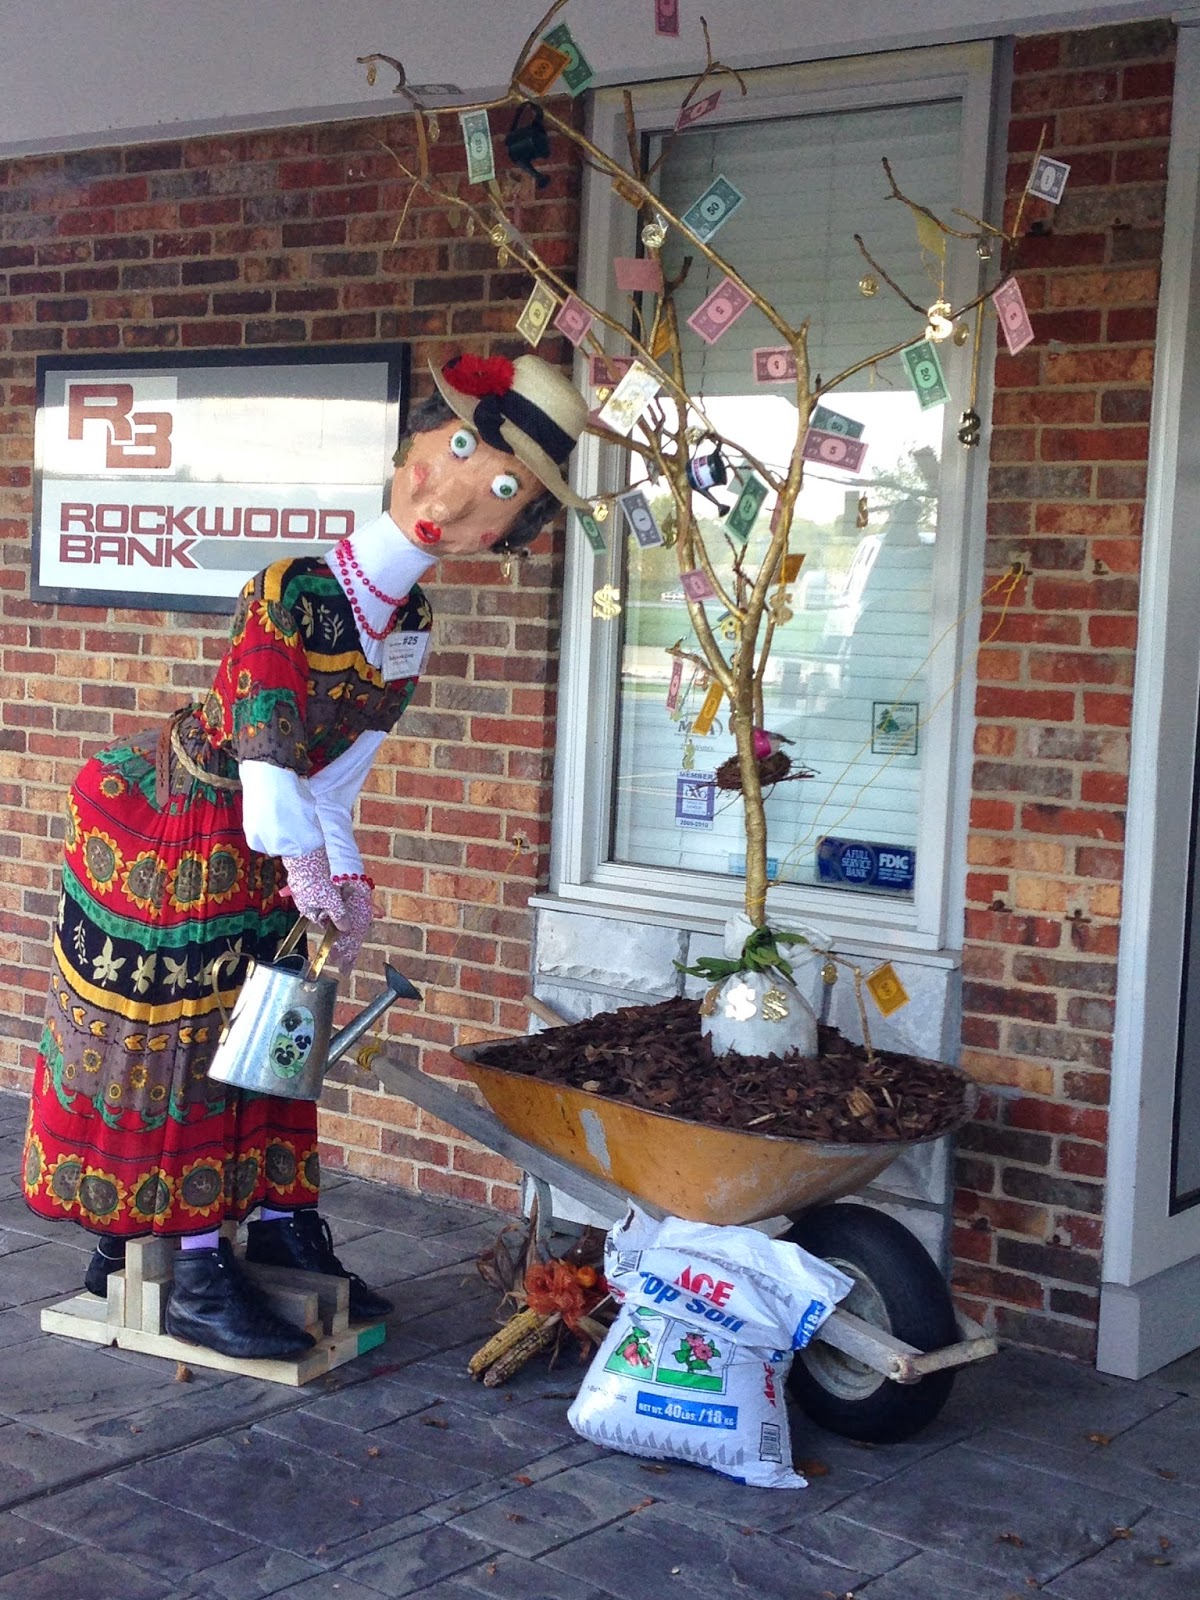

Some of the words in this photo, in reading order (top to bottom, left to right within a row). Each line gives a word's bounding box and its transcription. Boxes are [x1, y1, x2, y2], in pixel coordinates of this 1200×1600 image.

[706, 201, 720, 216] 50
[59, 502, 355, 540] ROCKWOOD
[59, 535, 198, 569] BANK
[879, 853, 909, 870] FDIC
[674, 1264, 735, 1308] ACE
[664, 1402, 682, 1419] 40
